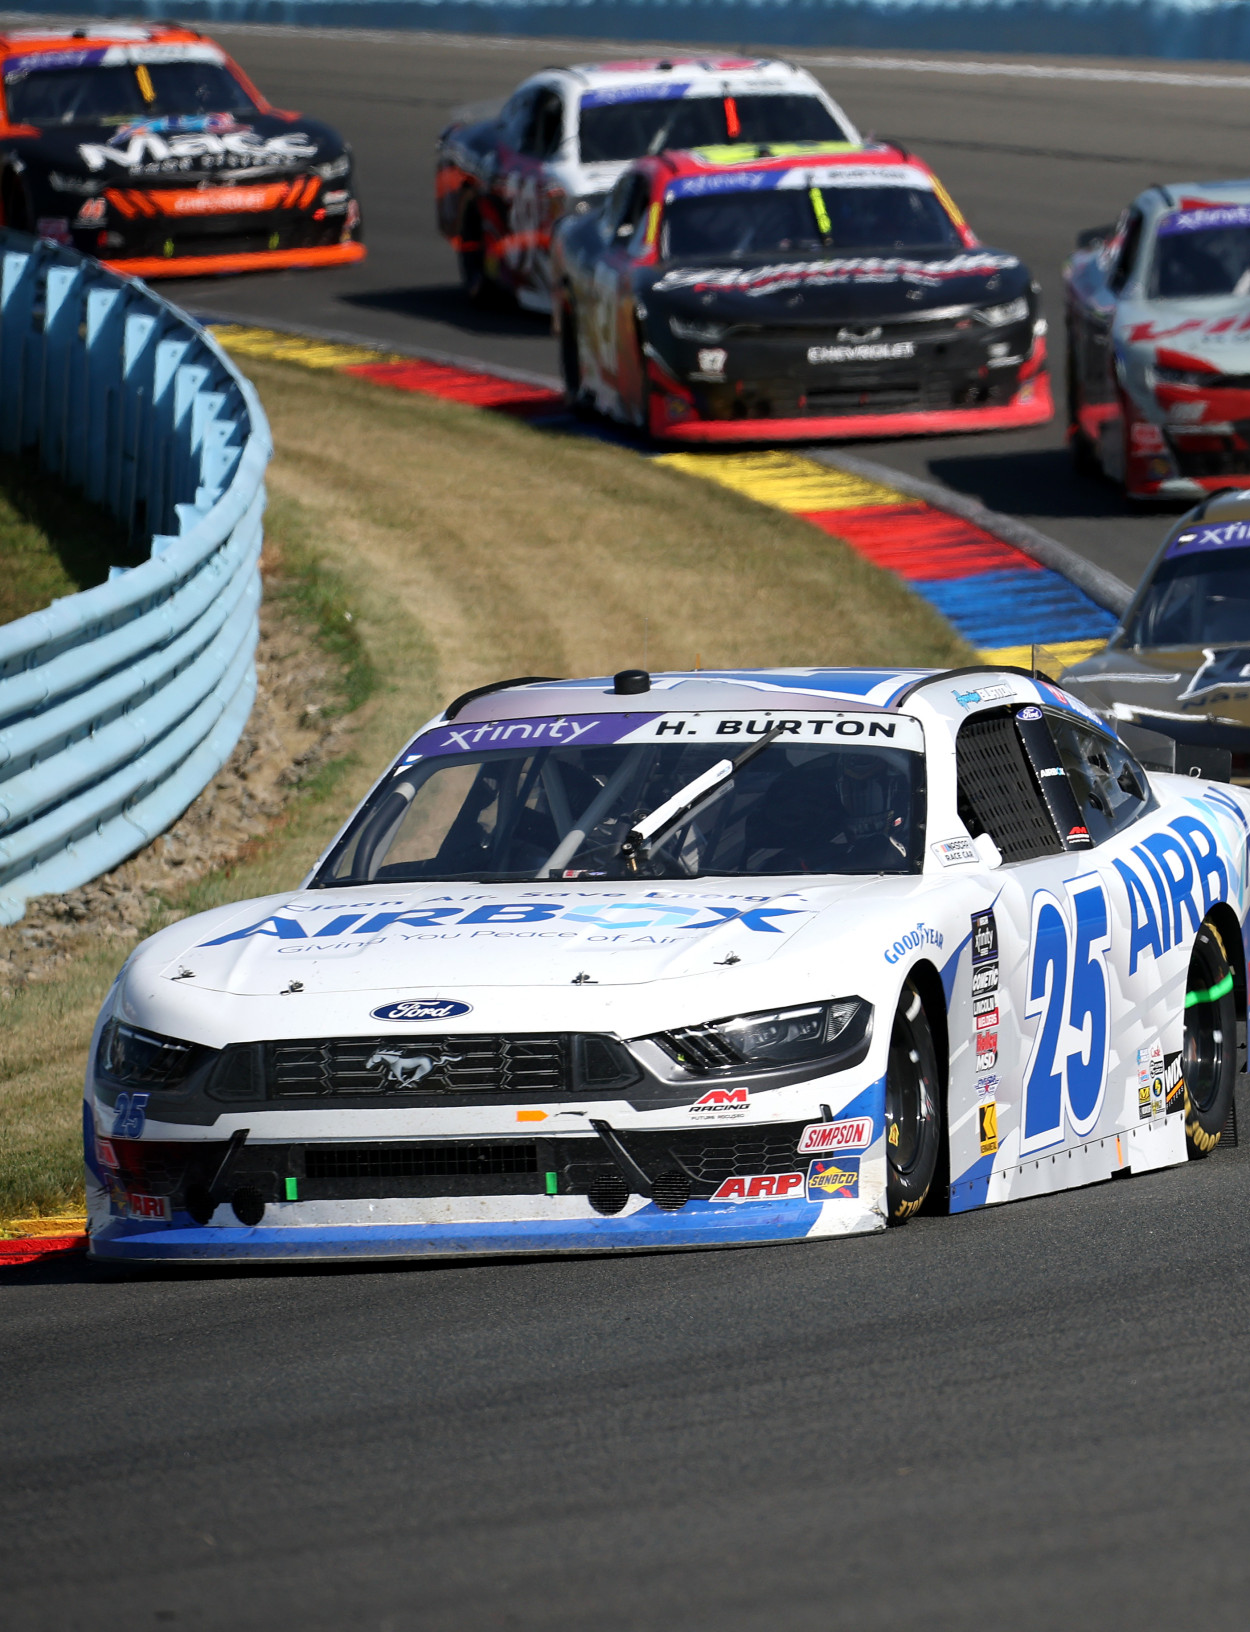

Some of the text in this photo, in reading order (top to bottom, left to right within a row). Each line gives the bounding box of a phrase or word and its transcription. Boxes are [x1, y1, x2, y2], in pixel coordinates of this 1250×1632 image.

[807, 341, 916, 364] CHEVROLET
[1022, 707, 1040, 719] Ford
[440, 719, 602, 750] xfinity
[655, 719, 896, 738] H. BURTON
[945, 850, 974, 862] RACE CAR
[277, 936, 387, 954] Giving
[400, 931, 461, 942] You
[470, 929, 579, 940] Peace
[586, 933, 619, 943] of
[883, 922, 944, 965] GOODYEAR
[386, 1000, 456, 1021] Ford
[1021, 873, 1110, 1152] 25
[976, 1051, 997, 1073] MSD
[1164, 1052, 1184, 1093] WIX
[688, 1103, 751, 1113] RACING
[697, 1088, 748, 1105] AM
[111, 1092, 151, 1139] 25
[804, 1123, 866, 1148] SIMPSON
[714, 1173, 802, 1198] ARP
[810, 1173, 856, 1187] SUNOCO
